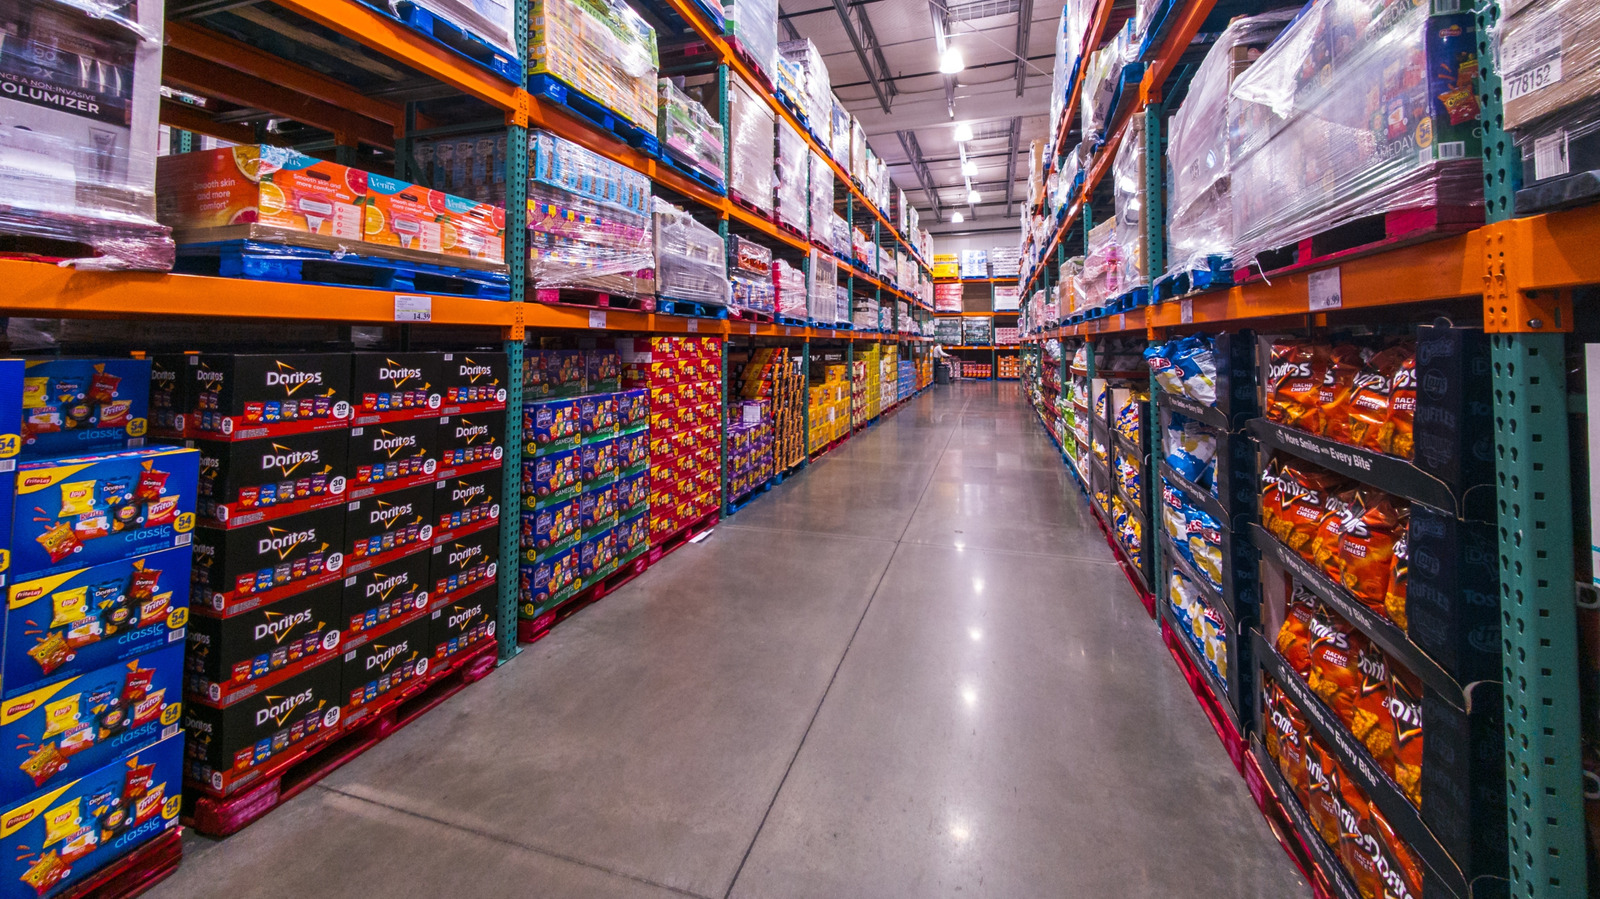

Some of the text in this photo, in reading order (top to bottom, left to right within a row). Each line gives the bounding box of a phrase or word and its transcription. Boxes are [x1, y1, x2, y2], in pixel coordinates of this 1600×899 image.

[1508, 64, 1551, 99] 778152
[0, 81, 100, 114] OLUMIZER
[30, 80, 96, 102] NON-INVASIVE
[193, 178, 235, 190] Smooth skin
[293, 174, 317, 184] Smooth
[371, 177, 396, 191] Venus
[197, 190, 231, 200] and more
[1326, 293, 1340, 306] 6.99
[152, 370, 175, 381] Doritos
[197, 370, 224, 381] Doritos
[379, 368, 421, 380] Doritos
[460, 365, 491, 375] Doritos
[266, 371, 322, 386] Doritos
[103, 404, 127, 415] Fritos
[1418, 406, 1455, 427] RUFFLES
[131, 420, 144, 430] 54
[456, 425, 488, 438] Doritos
[78, 427, 124, 440] classic
[373, 436, 416, 451] Doritos
[555, 437, 575, 446] GAMEDAY
[1284, 432, 1299, 446] More
[1300, 438, 1320, 453] Smiles
[1330, 448, 1352, 466] Every
[262, 450, 319, 469] Doritos
[453, 485, 485, 500] Doritos
[554, 487, 576, 497] GAMEDAY
[1278, 479, 1319, 504] oritos
[151, 501, 173, 514] Fritos
[370, 503, 412, 523] Doritos
[1299, 506, 1319, 515] NACHO
[179, 515, 191, 526] 54
[1296, 510, 1317, 520] CHEESE
[125, 525, 171, 542] classic
[422, 527, 431, 535] 30
[258, 528, 316, 555] Doritos
[554, 535, 575, 547] GAMEDAY
[329, 555, 340, 564] 30
[449, 544, 481, 564] Doritos
[366, 572, 408, 597] Doritos
[554, 586, 574, 600] GAMEDAY
[144, 598, 166, 613] Fritos
[1329, 590, 1352, 616] Every
[171, 609, 184, 622] 54
[449, 604, 481, 628] Doritos
[254, 608, 312, 641] Doritos
[118, 623, 164, 644] classic
[326, 633, 337, 642] 30
[366, 640, 408, 670] Doritos
[1323, 655, 1347, 668] CHEESE
[1325, 650, 1347, 662] NACHO
[418, 661, 426, 669] 30
[137, 696, 160, 713] Fritos
[256, 688, 313, 726] Doritos
[165, 707, 178, 719] 54
[327, 709, 338, 718] 30
[1287, 677, 1302, 698] More
[1302, 693, 1325, 725] Smiles
[1335, 733, 1357, 766] Every
[112, 721, 157, 747] classic
[139, 791, 160, 810] Fritos
[166, 798, 178, 813] 54
[114, 816, 159, 848] classic
